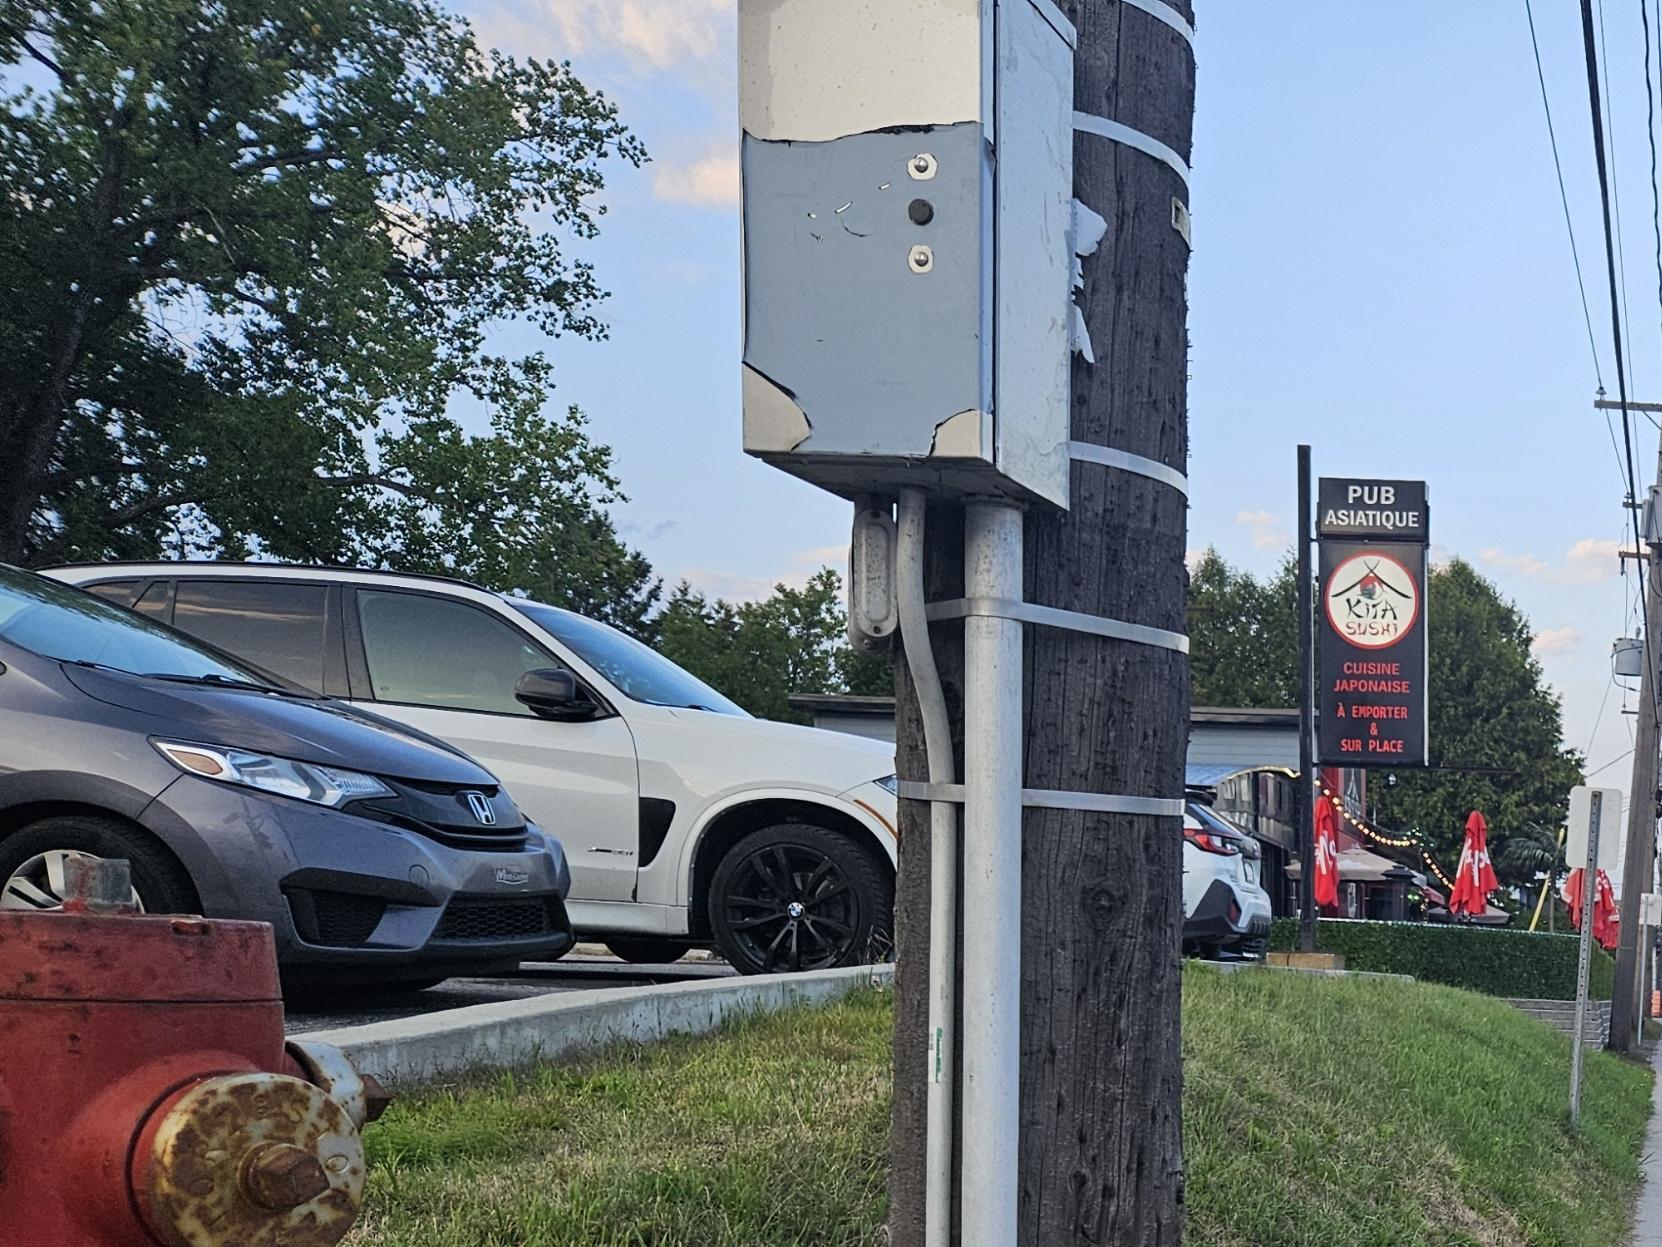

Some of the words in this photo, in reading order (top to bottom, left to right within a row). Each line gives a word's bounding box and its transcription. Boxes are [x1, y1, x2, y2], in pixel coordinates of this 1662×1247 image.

[1348, 485, 1396, 505] PUB
[1324, 509, 1419, 530] ASIATIQUE
[1343, 662, 1400, 676] CUISINE
[1333, 679, 1411, 694] JAPONAISE
[1337, 702, 1346, 718] À
[1352, 705, 1408, 719] EMPORTER
[1369, 722, 1378, 736] &
[1340, 739, 1362, 752] SUR
[1368, 740, 1404, 753] PLACE
